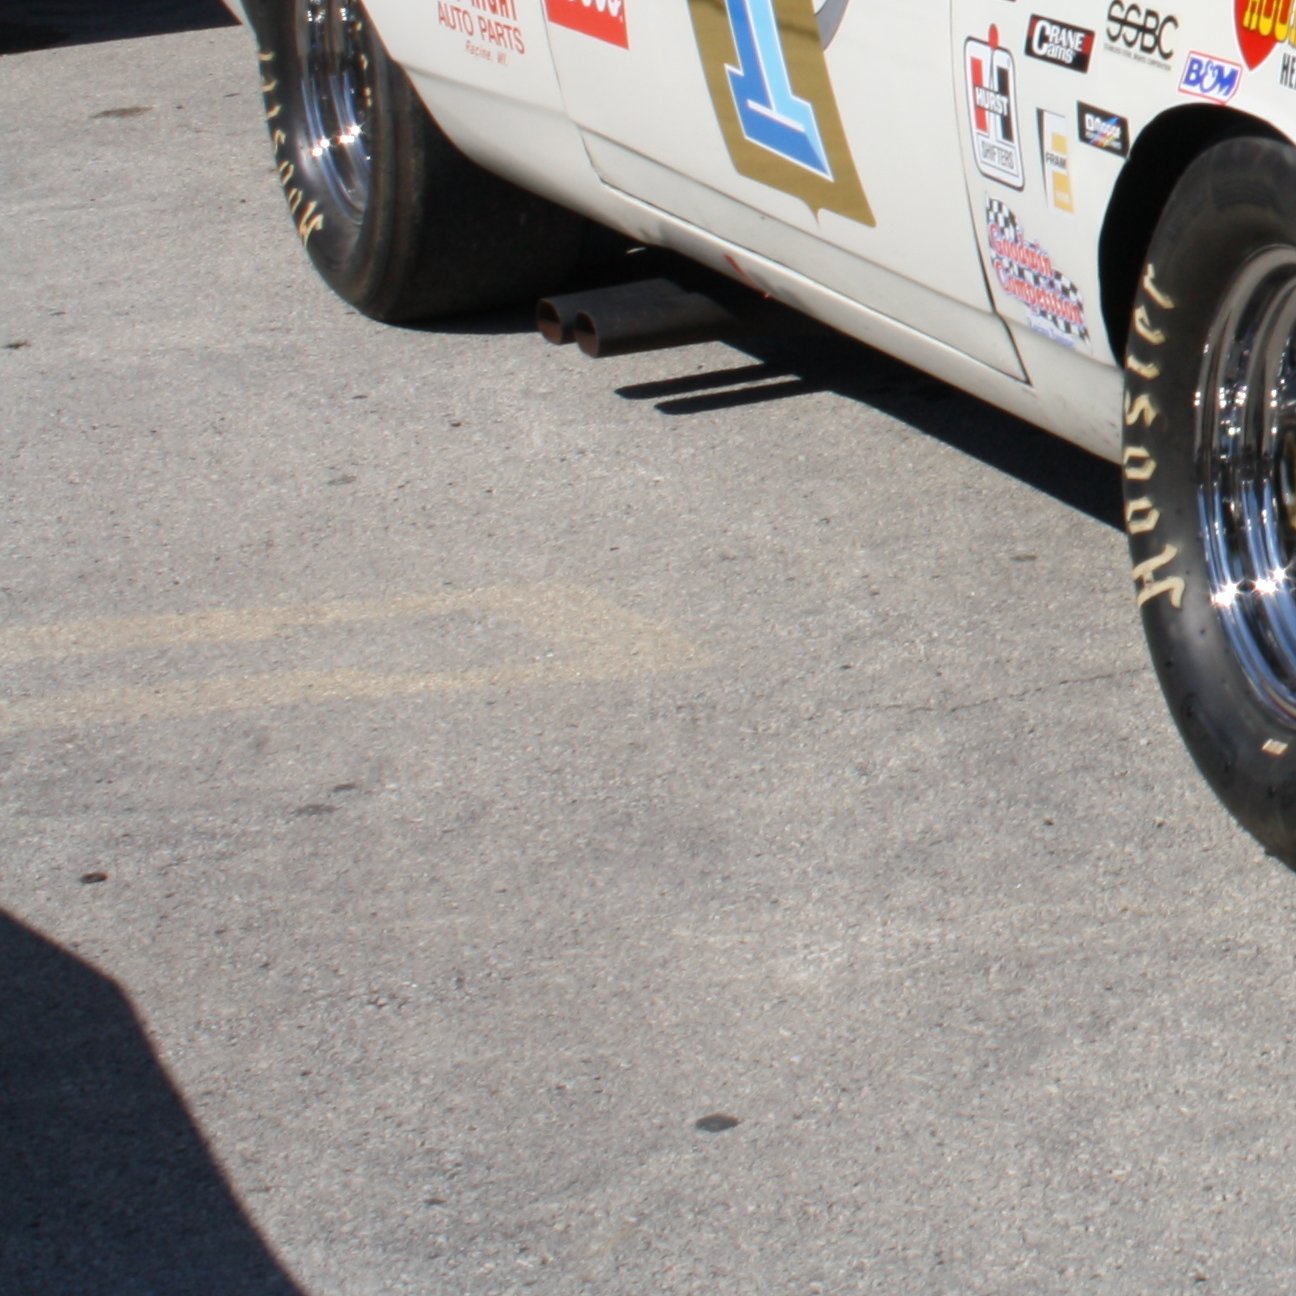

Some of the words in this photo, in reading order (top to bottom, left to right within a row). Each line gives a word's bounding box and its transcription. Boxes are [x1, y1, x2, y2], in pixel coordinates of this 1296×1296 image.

[438, 1, 474, 36] AUTO
[477, 15, 525, 54] PARTS
[1182, 57, 1239, 97] B&M
[975, 87, 1009, 117] HURST
[1045, 152, 1067, 170] FRAM
[1126, 265, 1184, 608] Hoosier
